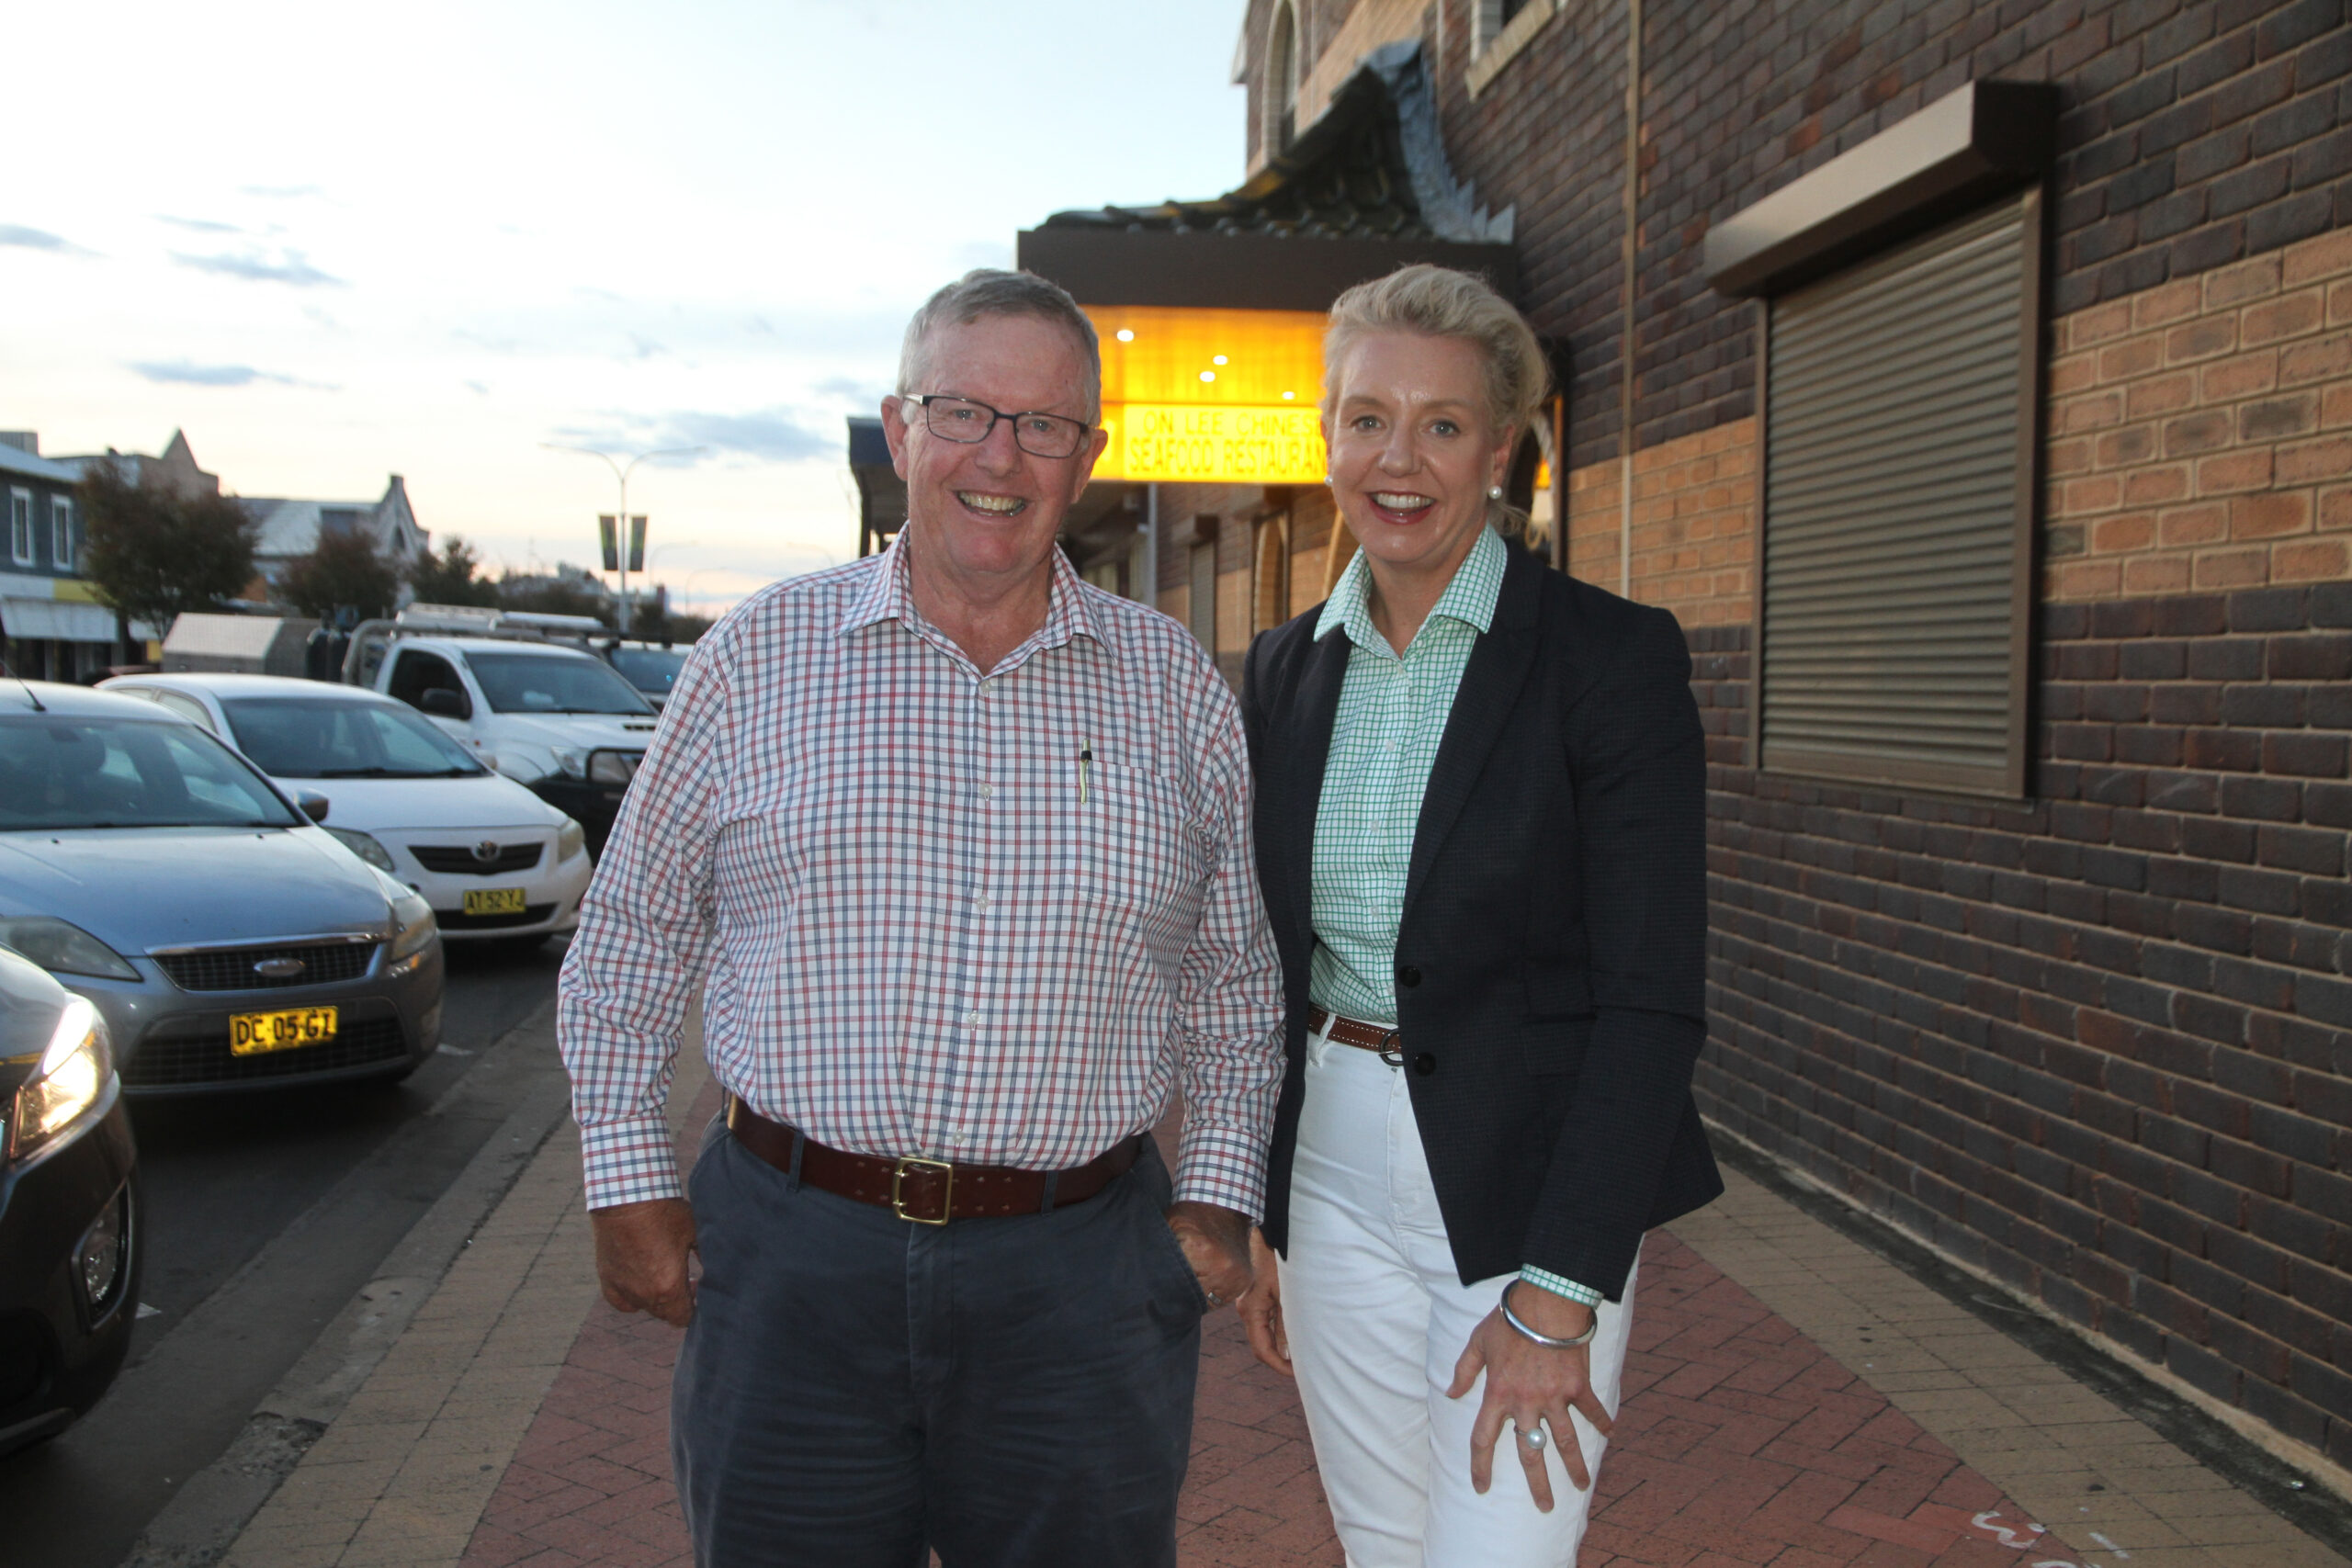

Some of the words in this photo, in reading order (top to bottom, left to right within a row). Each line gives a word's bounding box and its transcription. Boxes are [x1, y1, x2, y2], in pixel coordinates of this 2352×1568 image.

[1143, 411, 1174, 434] ON
[1185, 411, 1224, 435] LEE
[1236, 412, 1320, 437] CHINES
[1131, 436, 1214, 474] SEAFOOD
[1224, 438, 1327, 475] RESTAURAN
